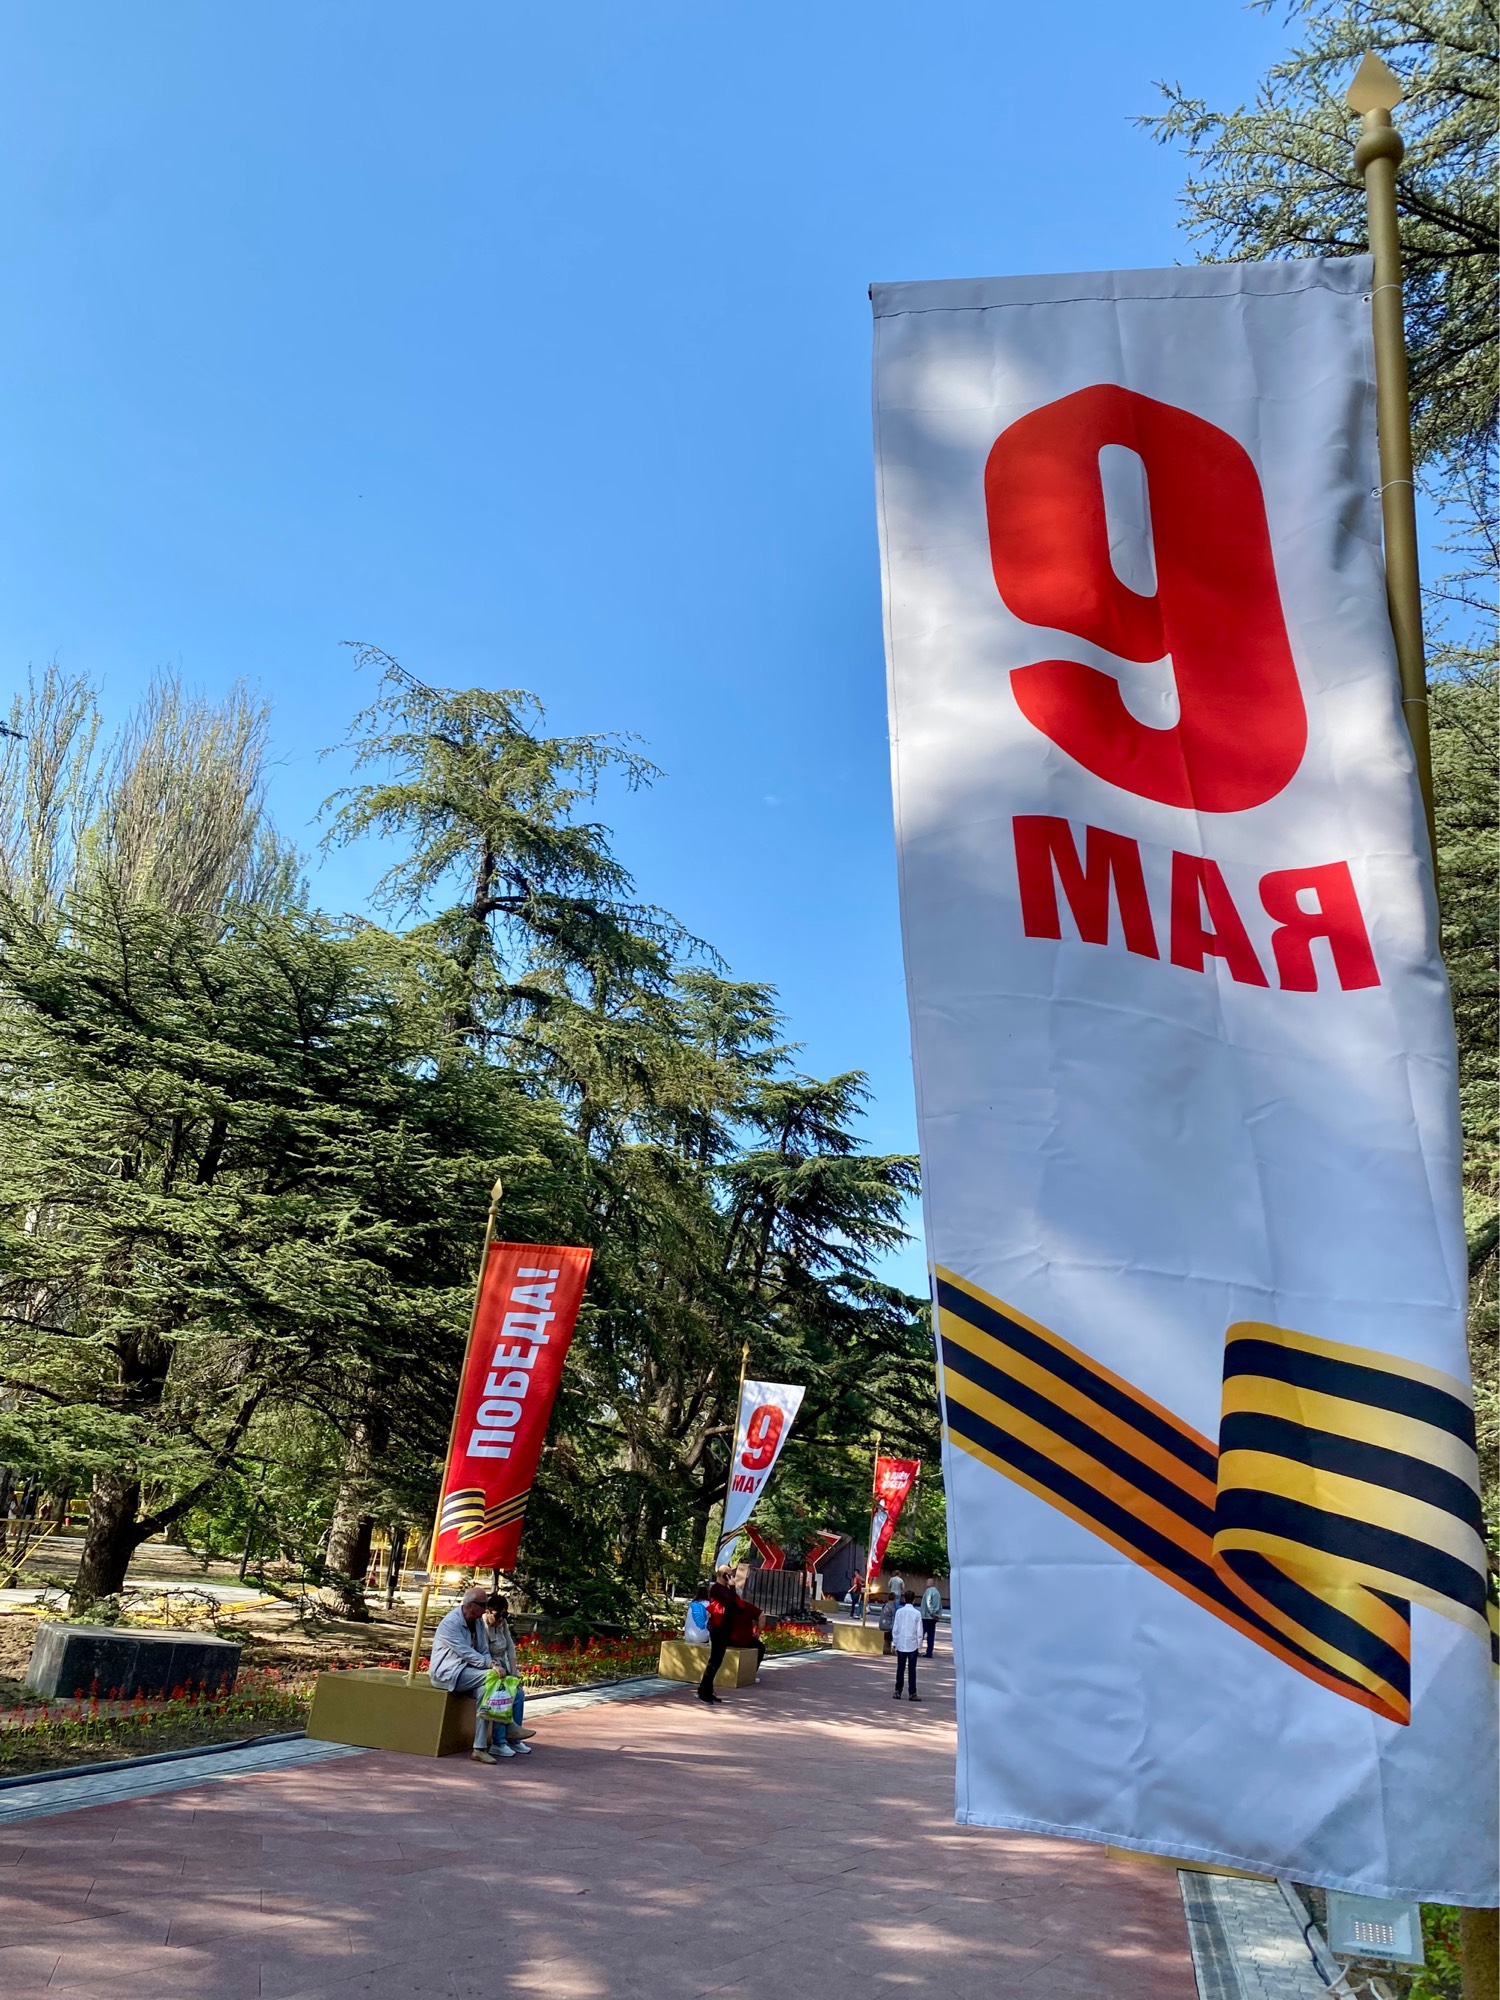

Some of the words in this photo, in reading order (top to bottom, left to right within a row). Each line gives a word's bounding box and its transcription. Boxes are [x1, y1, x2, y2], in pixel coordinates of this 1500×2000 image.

[984, 383, 1308, 814] 9
[1012, 814, 1381, 993] МАЯ
[466, 1267, 560, 1459] ПОБЕДА!
[741, 1404, 784, 1471] 9
